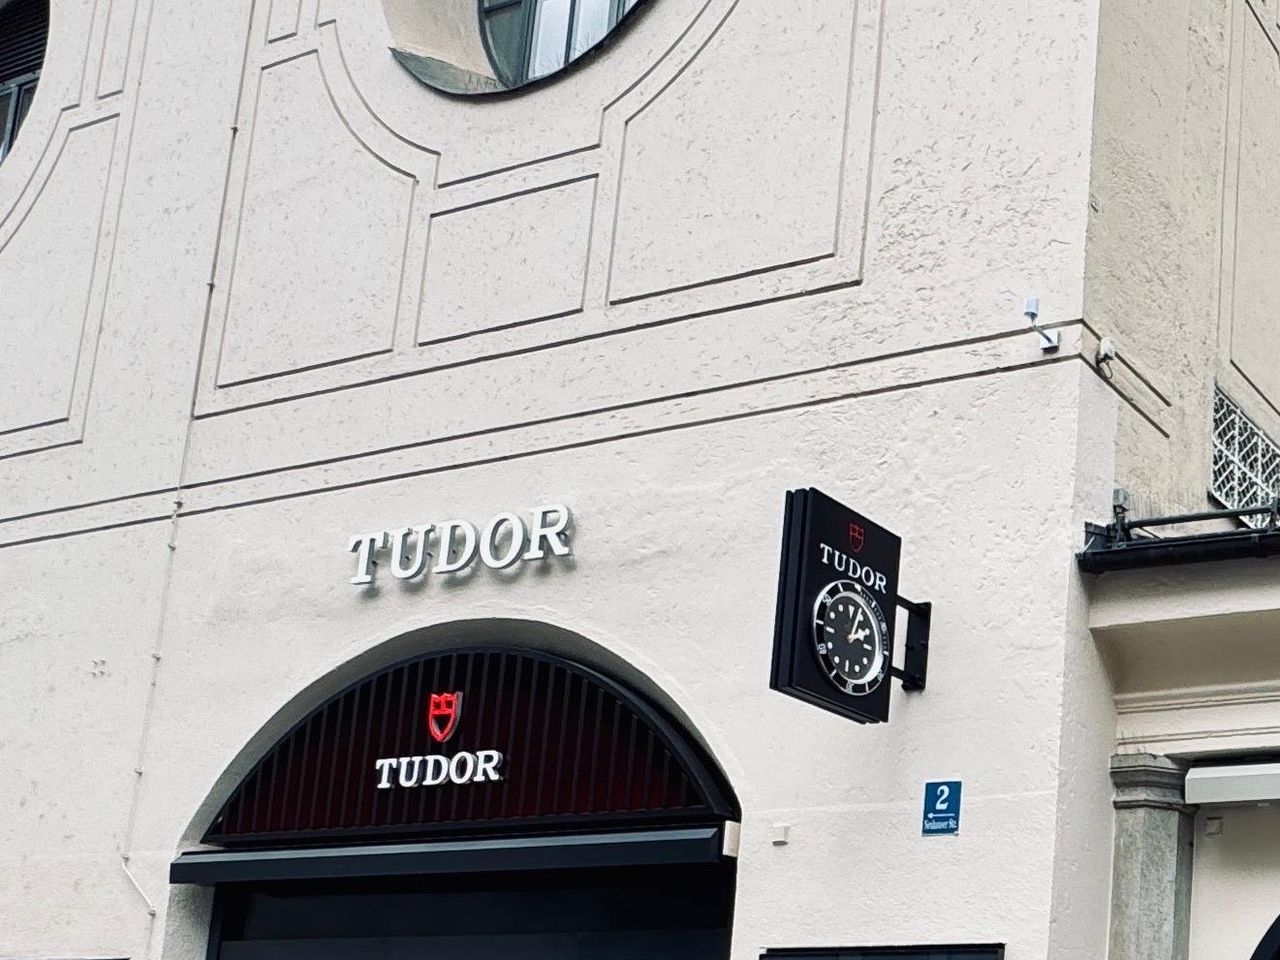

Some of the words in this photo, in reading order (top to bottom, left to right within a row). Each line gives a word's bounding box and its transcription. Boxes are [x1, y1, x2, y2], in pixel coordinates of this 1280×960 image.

[349, 503, 573, 584] TUDOR
[819, 542, 888, 594] TUDOR
[375, 749, 503, 789] TUDOR
[935, 784, 950, 810] 2
